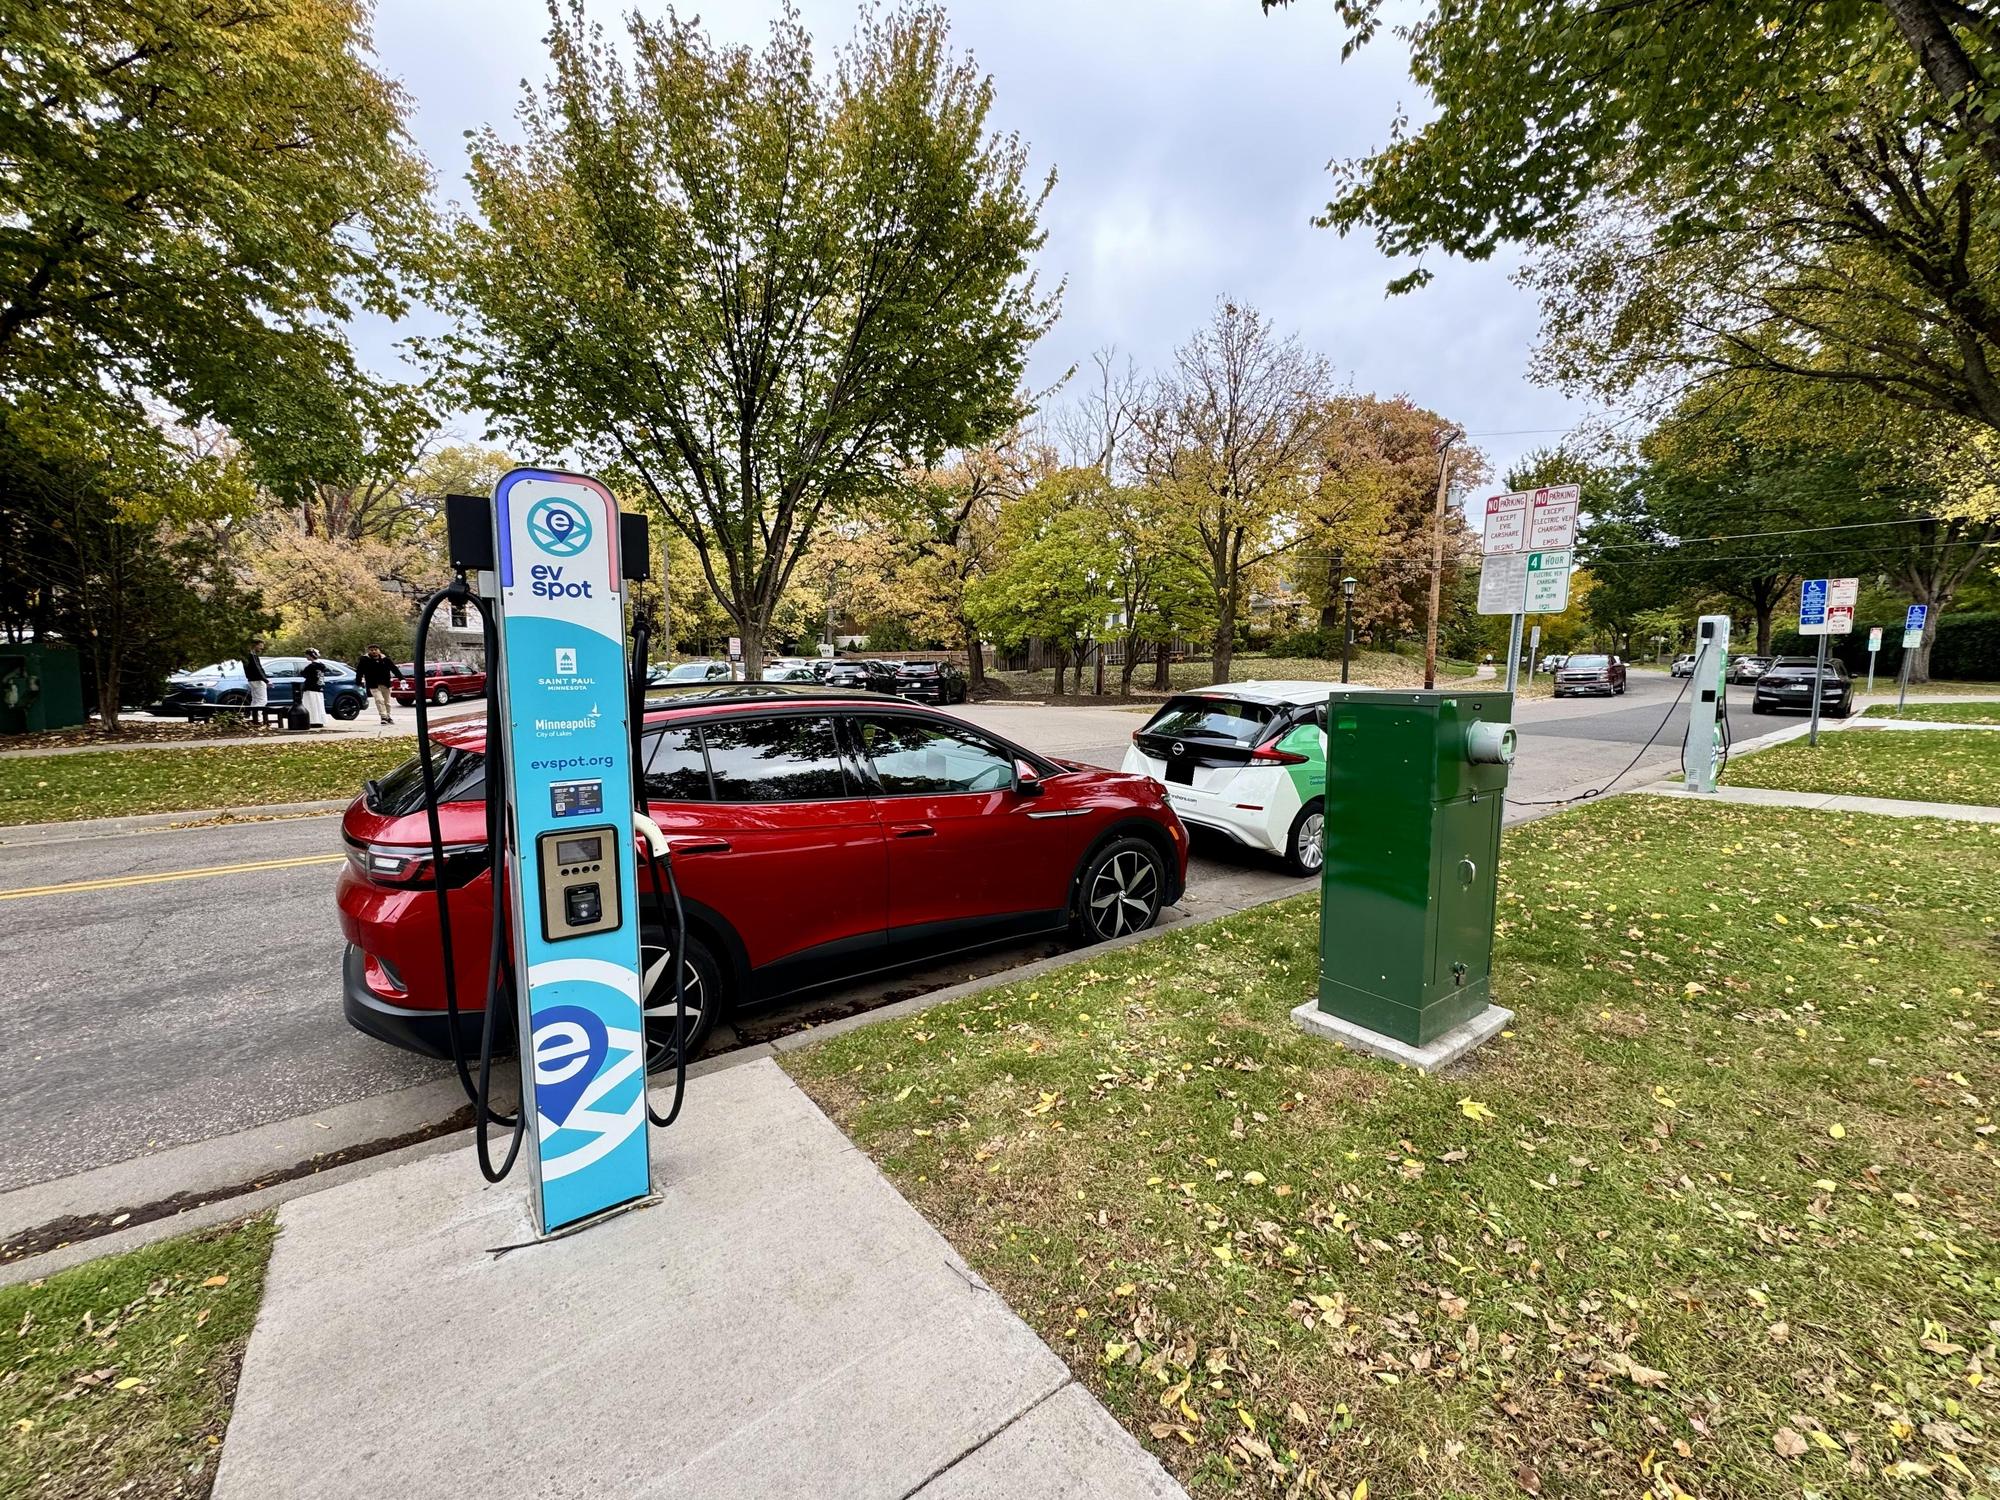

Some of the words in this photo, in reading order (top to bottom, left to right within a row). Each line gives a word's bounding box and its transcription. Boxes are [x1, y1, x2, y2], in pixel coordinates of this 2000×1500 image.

[1536, 492, 1547, 504] NO
[1549, 490, 1575, 500] PARKING
[1488, 499, 1498, 511] NO
[1500, 498, 1525, 508] PARKING
[1543, 507, 1565, 515] EXCEPT
[1496, 514, 1516, 522] EXCEPT
[1534, 517, 1559, 525] ELECTRIC
[1491, 530, 1519, 539] CARSHARE
[1538, 525, 1567, 533] CHARGING
[1531, 556, 1538, 568] 4
[1545, 556, 1564, 565] HOUR
[531, 564, 563, 581] ev
[532, 580, 592, 600] spot
[535, 718, 596, 731] Minneapolis
[531, 756, 614, 771] evspot.org
